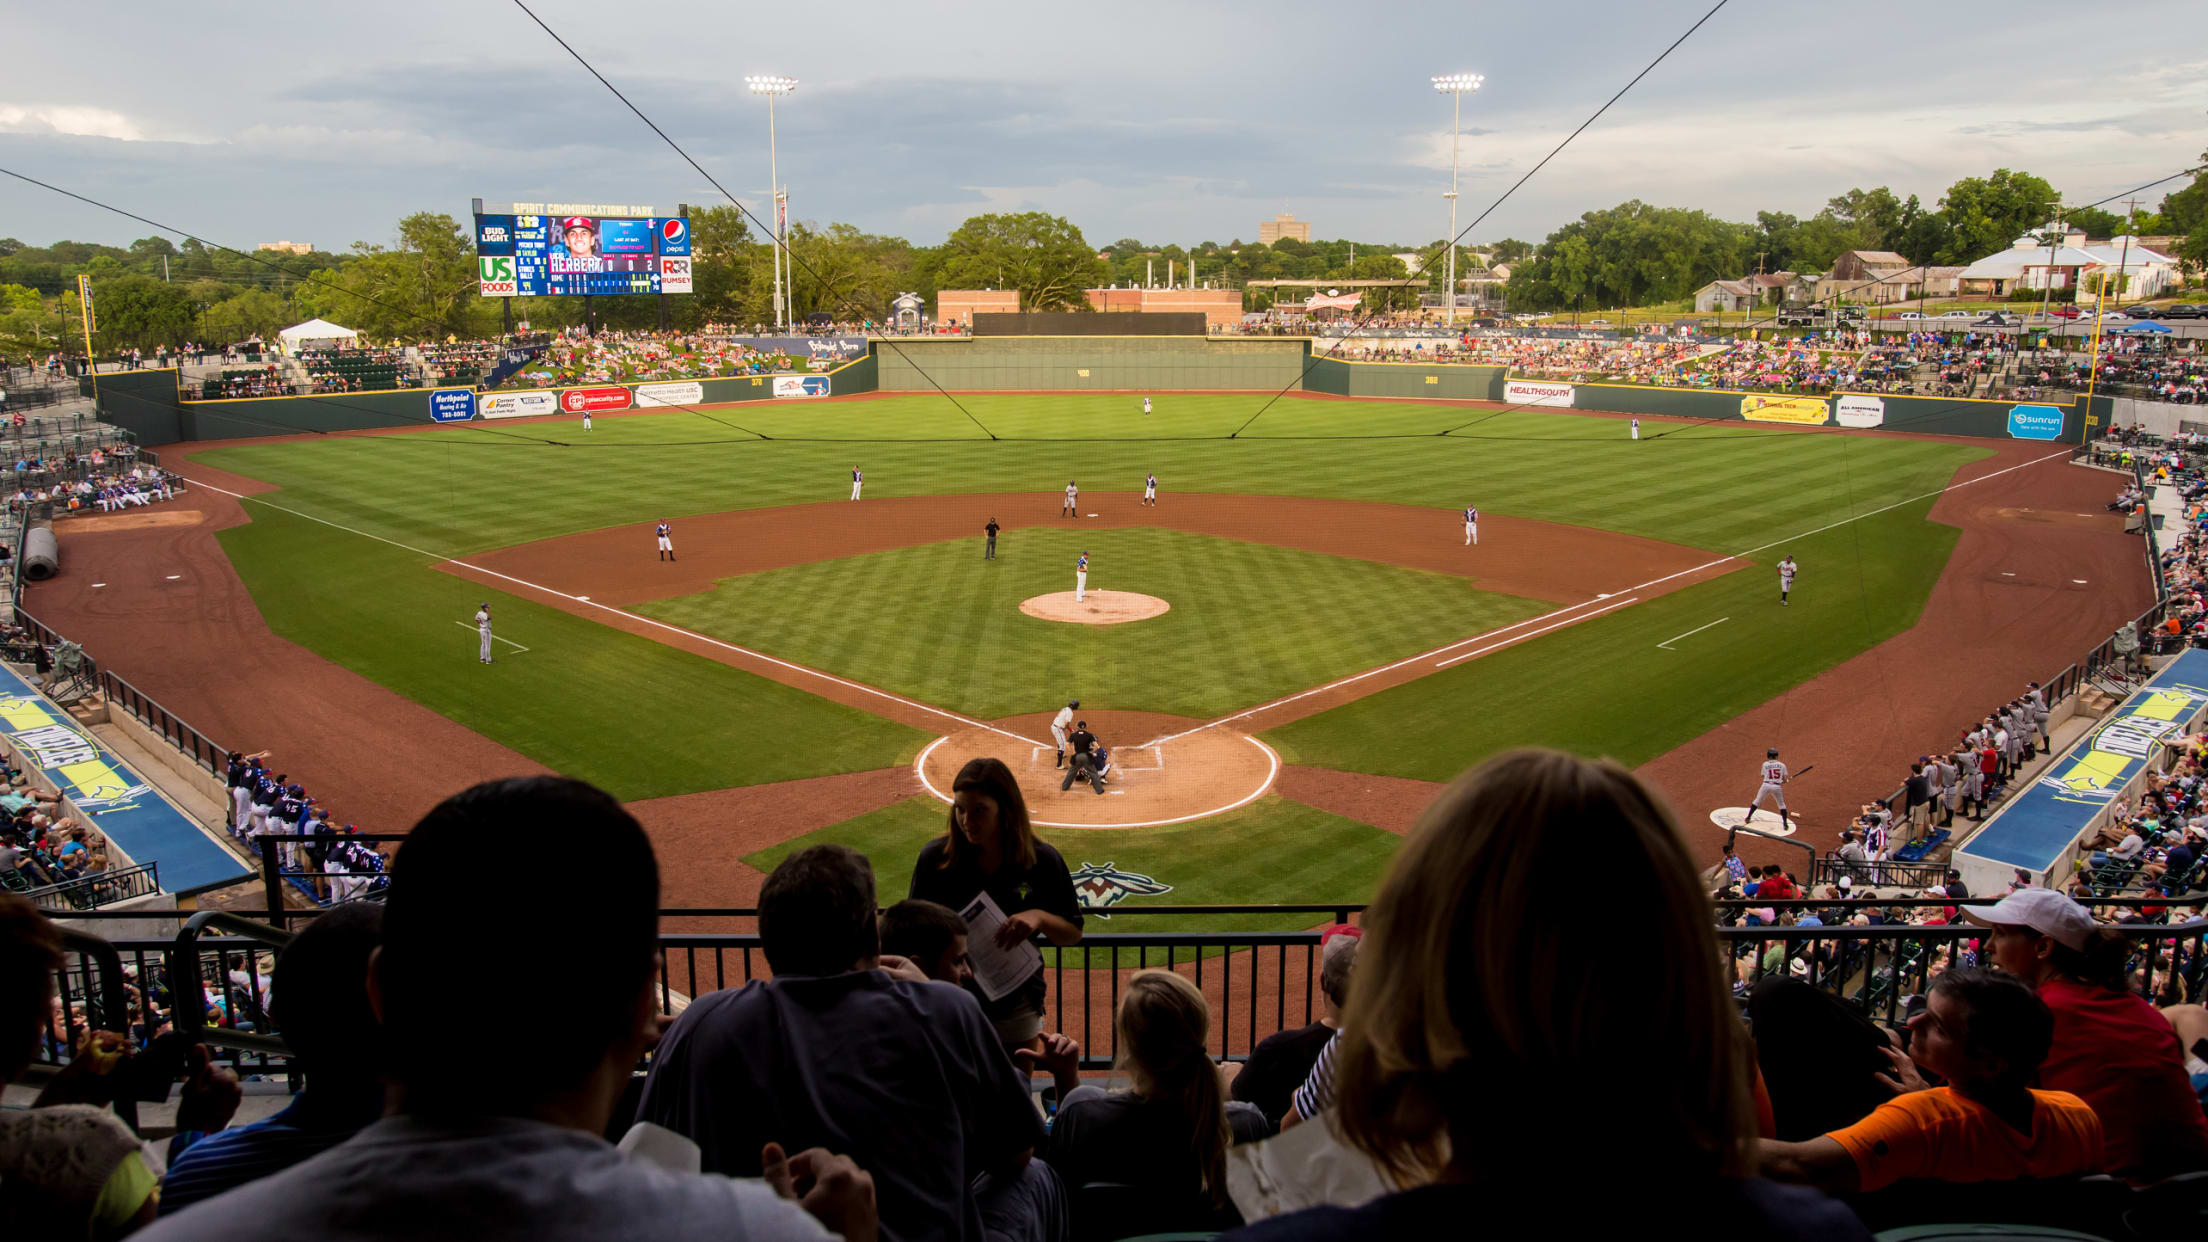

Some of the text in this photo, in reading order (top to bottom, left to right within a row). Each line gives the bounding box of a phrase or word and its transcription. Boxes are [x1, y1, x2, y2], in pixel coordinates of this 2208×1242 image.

[513, 203, 654, 217] SPIRIT COMMUNICATIONS PARK
[484, 227, 505, 235] BUD
[481, 234, 509, 242] LIGHT
[666, 245, 684, 253] pepsi
[551, 258, 602, 273] HERBERT
[647, 260, 653, 271] 2
[481, 282, 514, 292] FOODS
[1509, 386, 1570, 397] HEALTHSOUTH
[435, 394, 470, 404] Northpoint
[2027, 416, 2060, 425] sunrun
[1768, 769, 1780, 779] 15
[285, 803, 299, 813] 45
